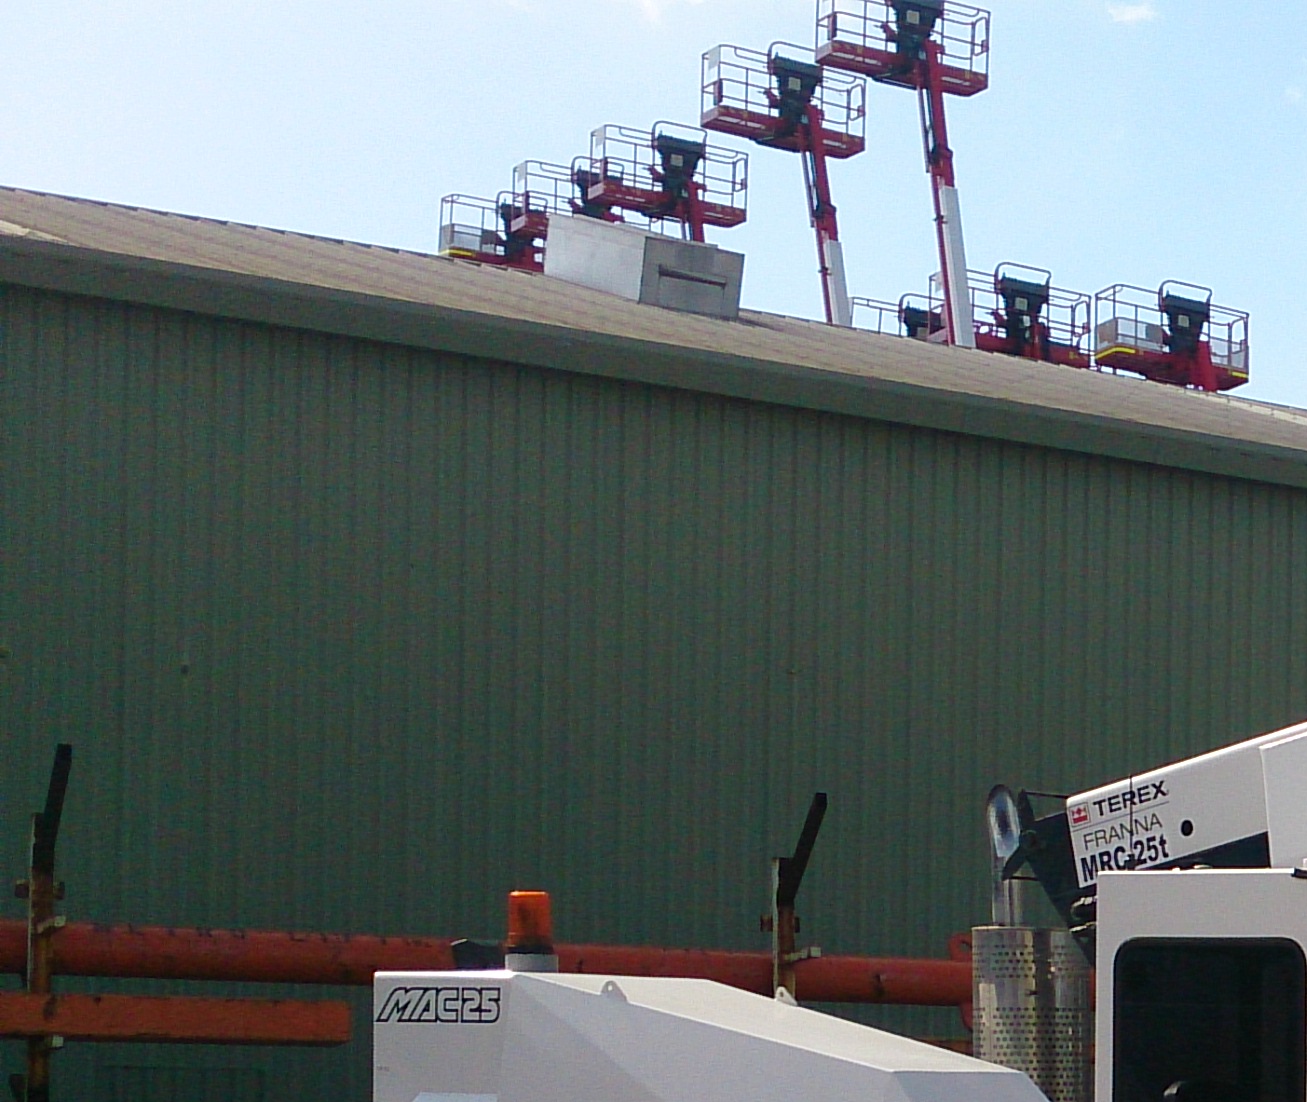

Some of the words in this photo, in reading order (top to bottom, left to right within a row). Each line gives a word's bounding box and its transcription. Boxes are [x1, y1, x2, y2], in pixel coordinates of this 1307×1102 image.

[1093, 780, 1168, 816] TEREX
[1083, 812, 1163, 851] FRANNA
[375, 986, 499, 1023] MAC25
